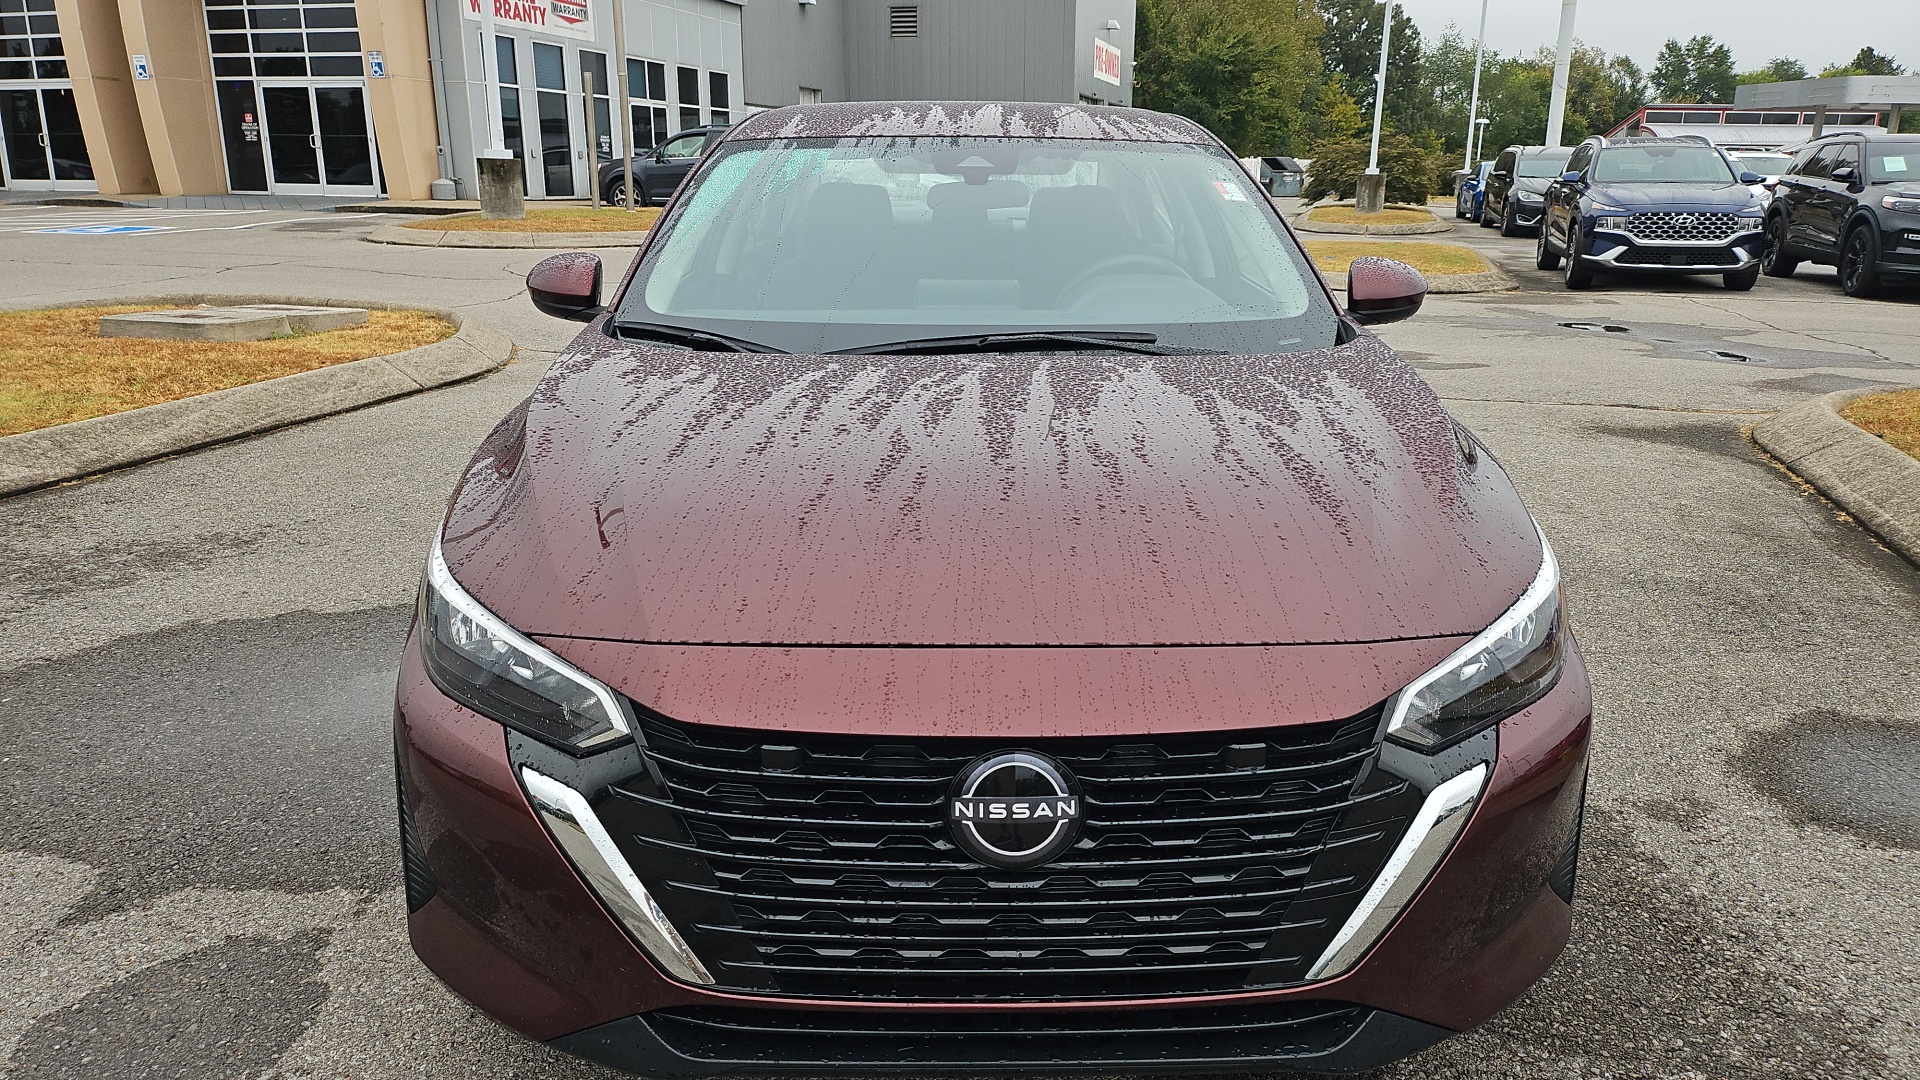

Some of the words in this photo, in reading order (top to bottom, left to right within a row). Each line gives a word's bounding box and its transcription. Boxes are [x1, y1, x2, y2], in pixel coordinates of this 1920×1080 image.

[469, 0, 547, 26] WRRANTY
[552, 2, 588, 20] WARRANTY
[1095, 44, 1120, 79] PRE-OWNED
[954, 800, 1076, 819] NISSAN
